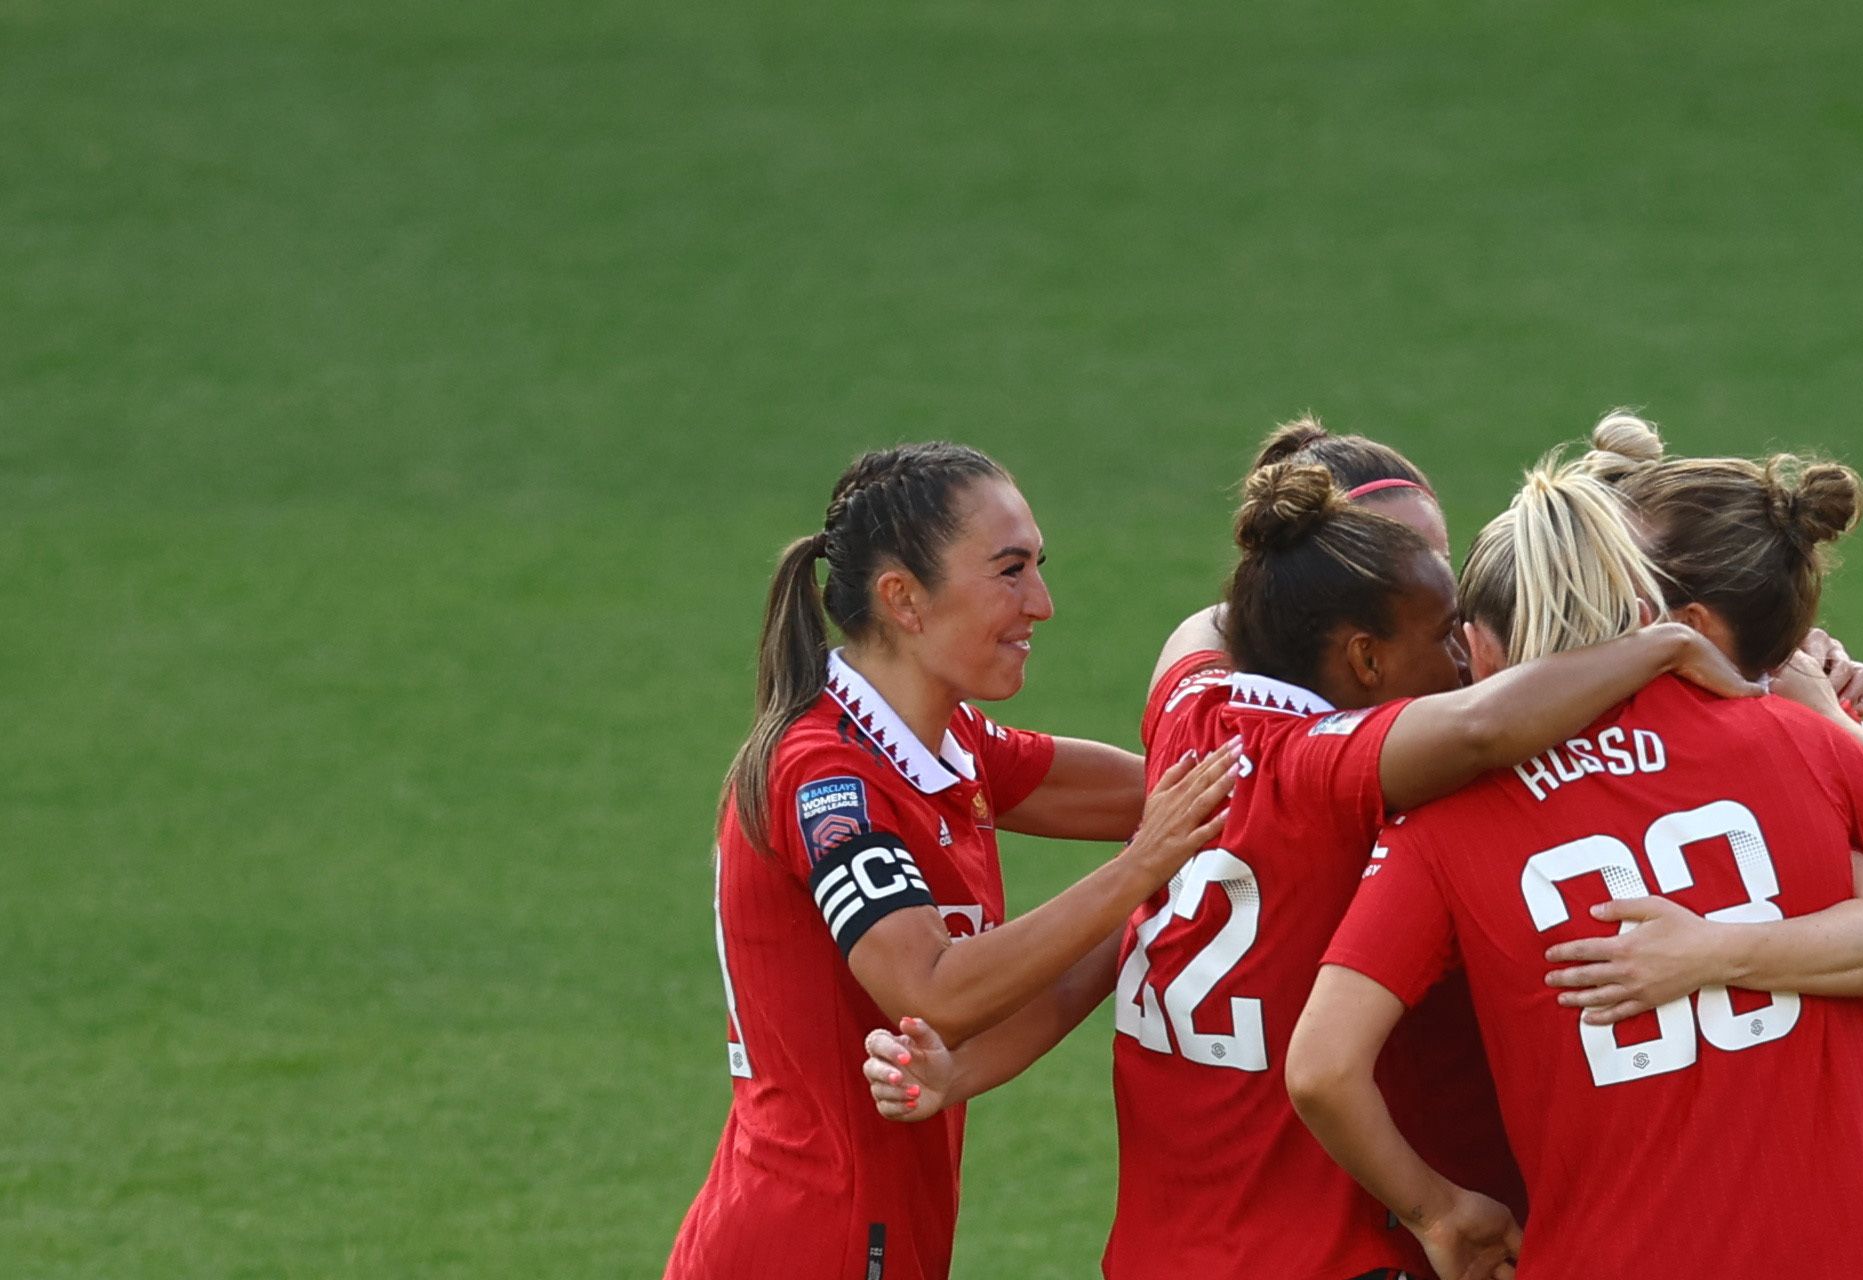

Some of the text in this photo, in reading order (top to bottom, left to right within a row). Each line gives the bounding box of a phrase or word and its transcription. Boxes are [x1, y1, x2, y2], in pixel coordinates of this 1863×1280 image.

[810, 783, 857, 799] BARCLAYS
[802, 791, 858, 812] WOMEN'S
[803, 800, 859, 820] SUPER LEAGUE
[851, 847, 908, 899] C
